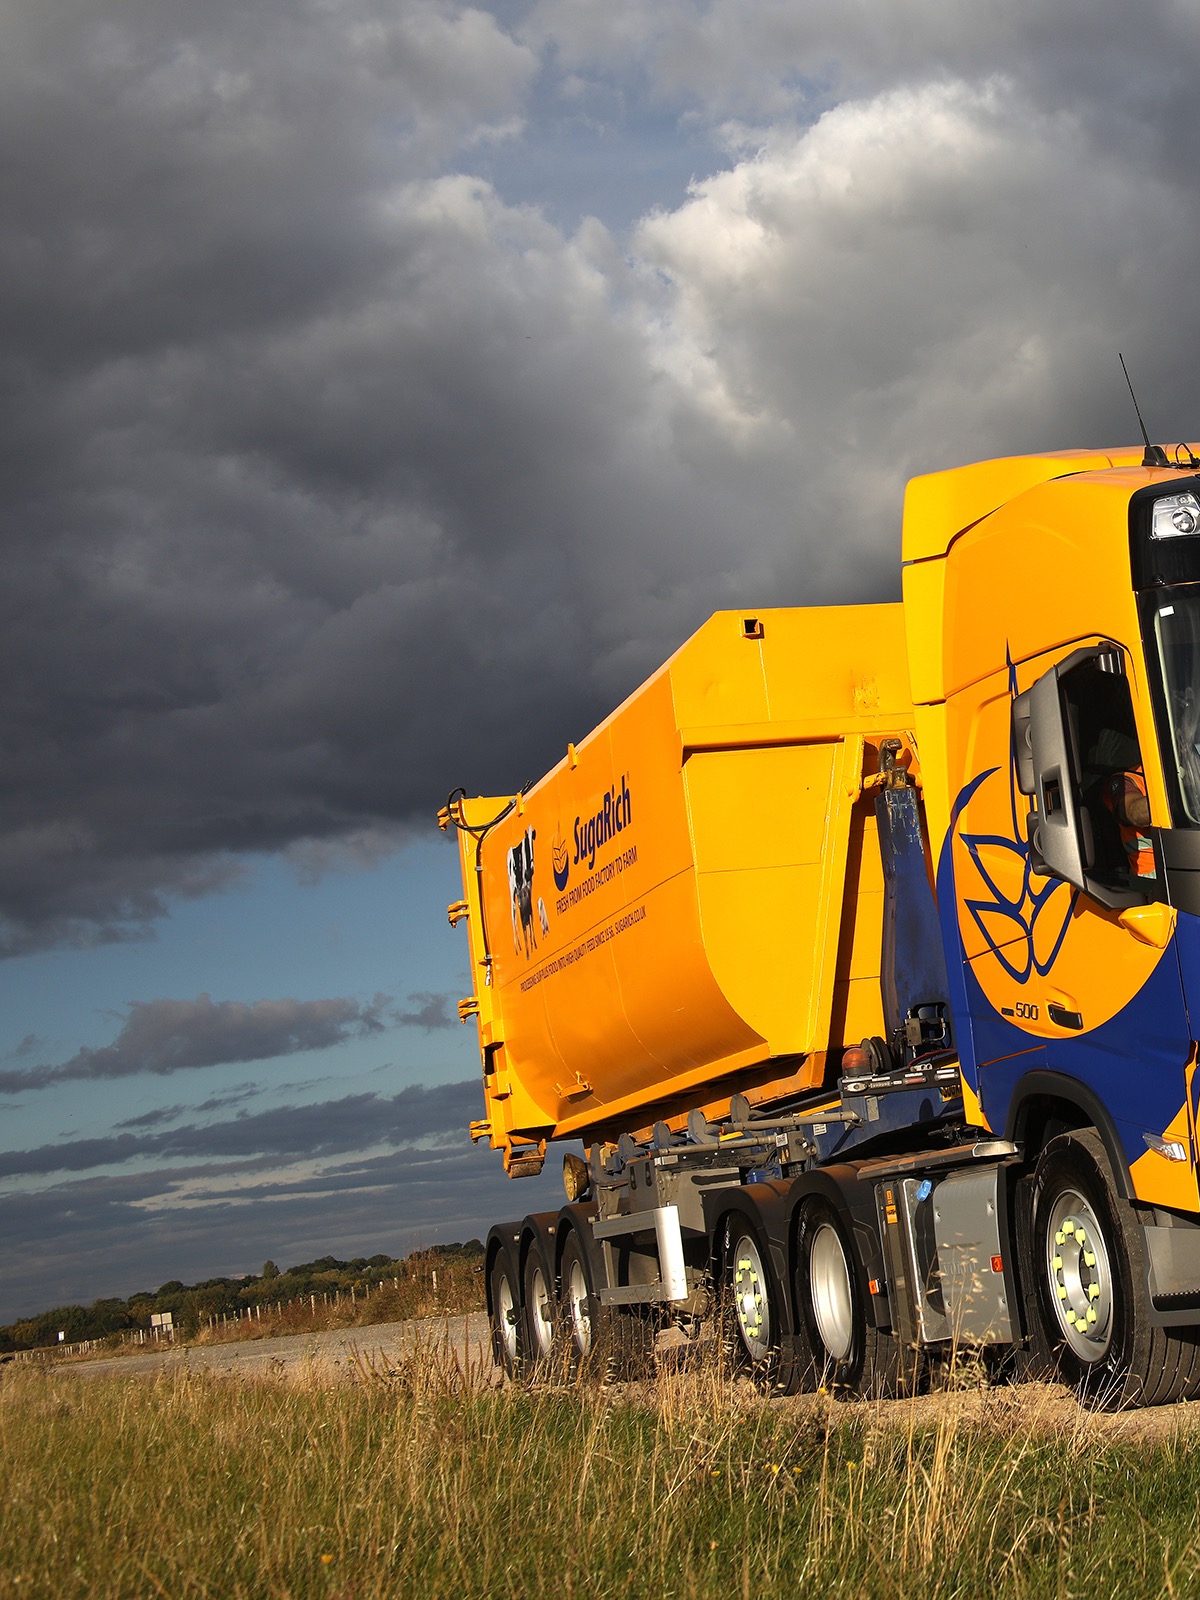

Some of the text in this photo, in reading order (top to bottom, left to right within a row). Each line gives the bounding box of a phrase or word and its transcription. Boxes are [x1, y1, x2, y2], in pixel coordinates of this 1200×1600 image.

[573, 775, 632, 870] SugaRich
[556, 845, 638, 916] FRESH FROM FOOD FACTORY TO FARM
[1016, 1002, 1038, 1020] 500
